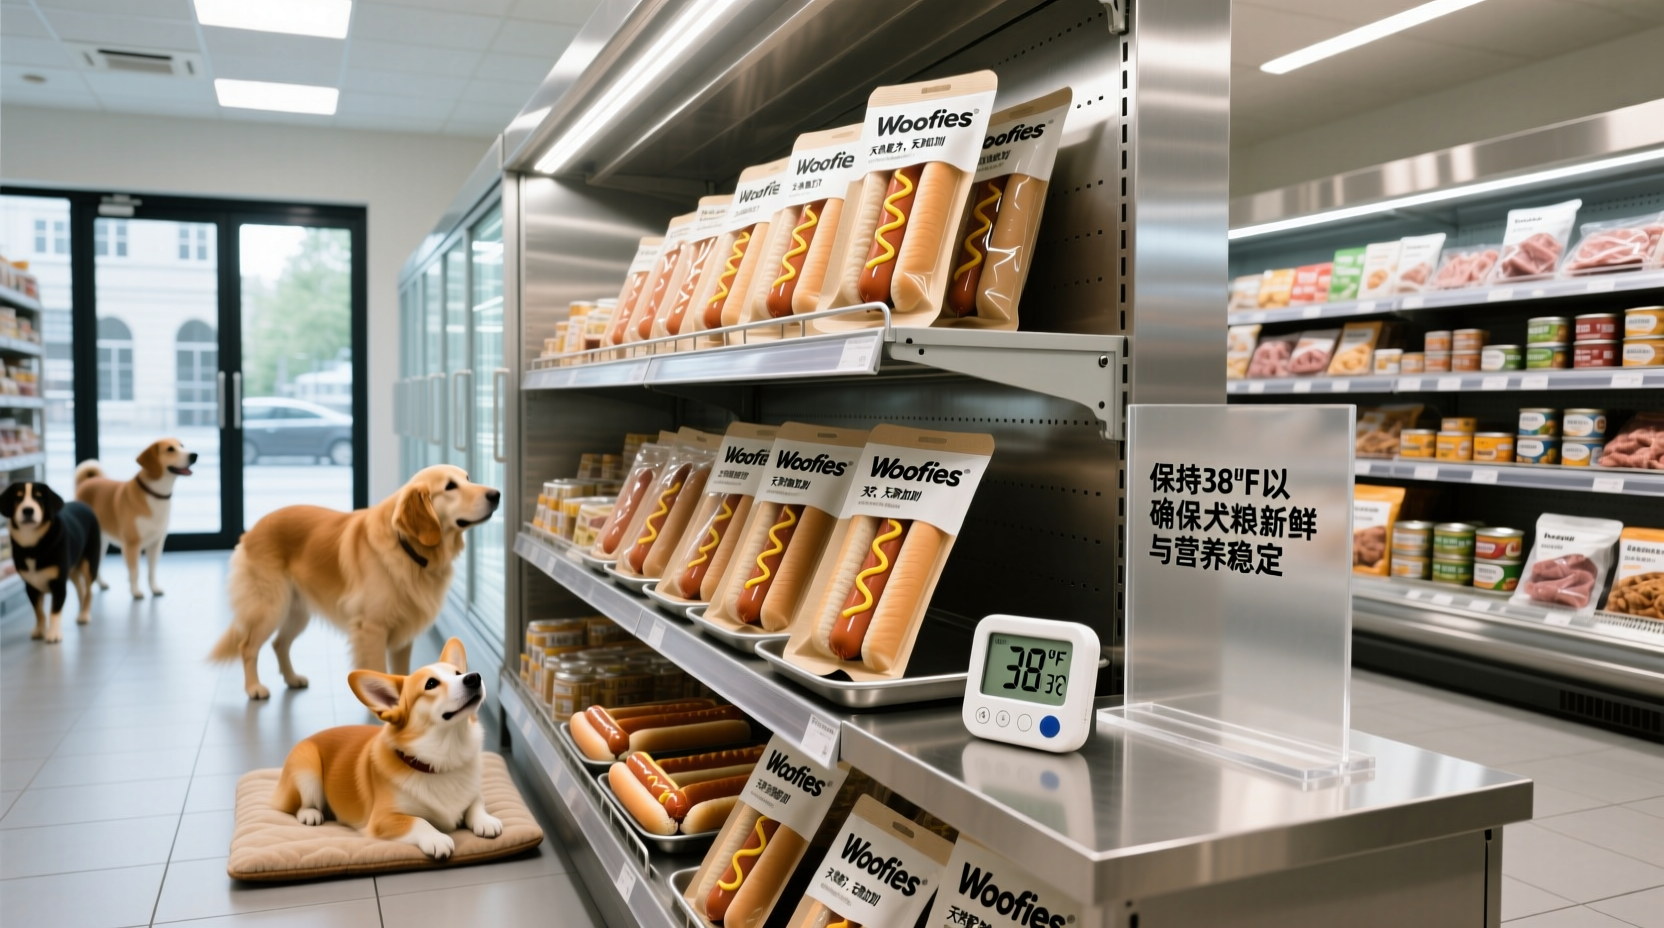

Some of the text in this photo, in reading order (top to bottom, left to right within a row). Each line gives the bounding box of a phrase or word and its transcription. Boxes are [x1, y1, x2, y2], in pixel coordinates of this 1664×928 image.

[878, 108, 973, 137] Woofies
[983, 124, 1046, 149] oofies
[776, 450, 847, 476] Woofies
[870, 456, 963, 487] Woofies
[1149, 497, 1318, 541] 确保犬粮新鲜
[1149, 534, 1284, 577] 与营养稳定
[765, 749, 826, 797] Woofies
[841, 833, 921, 897] Woofies
